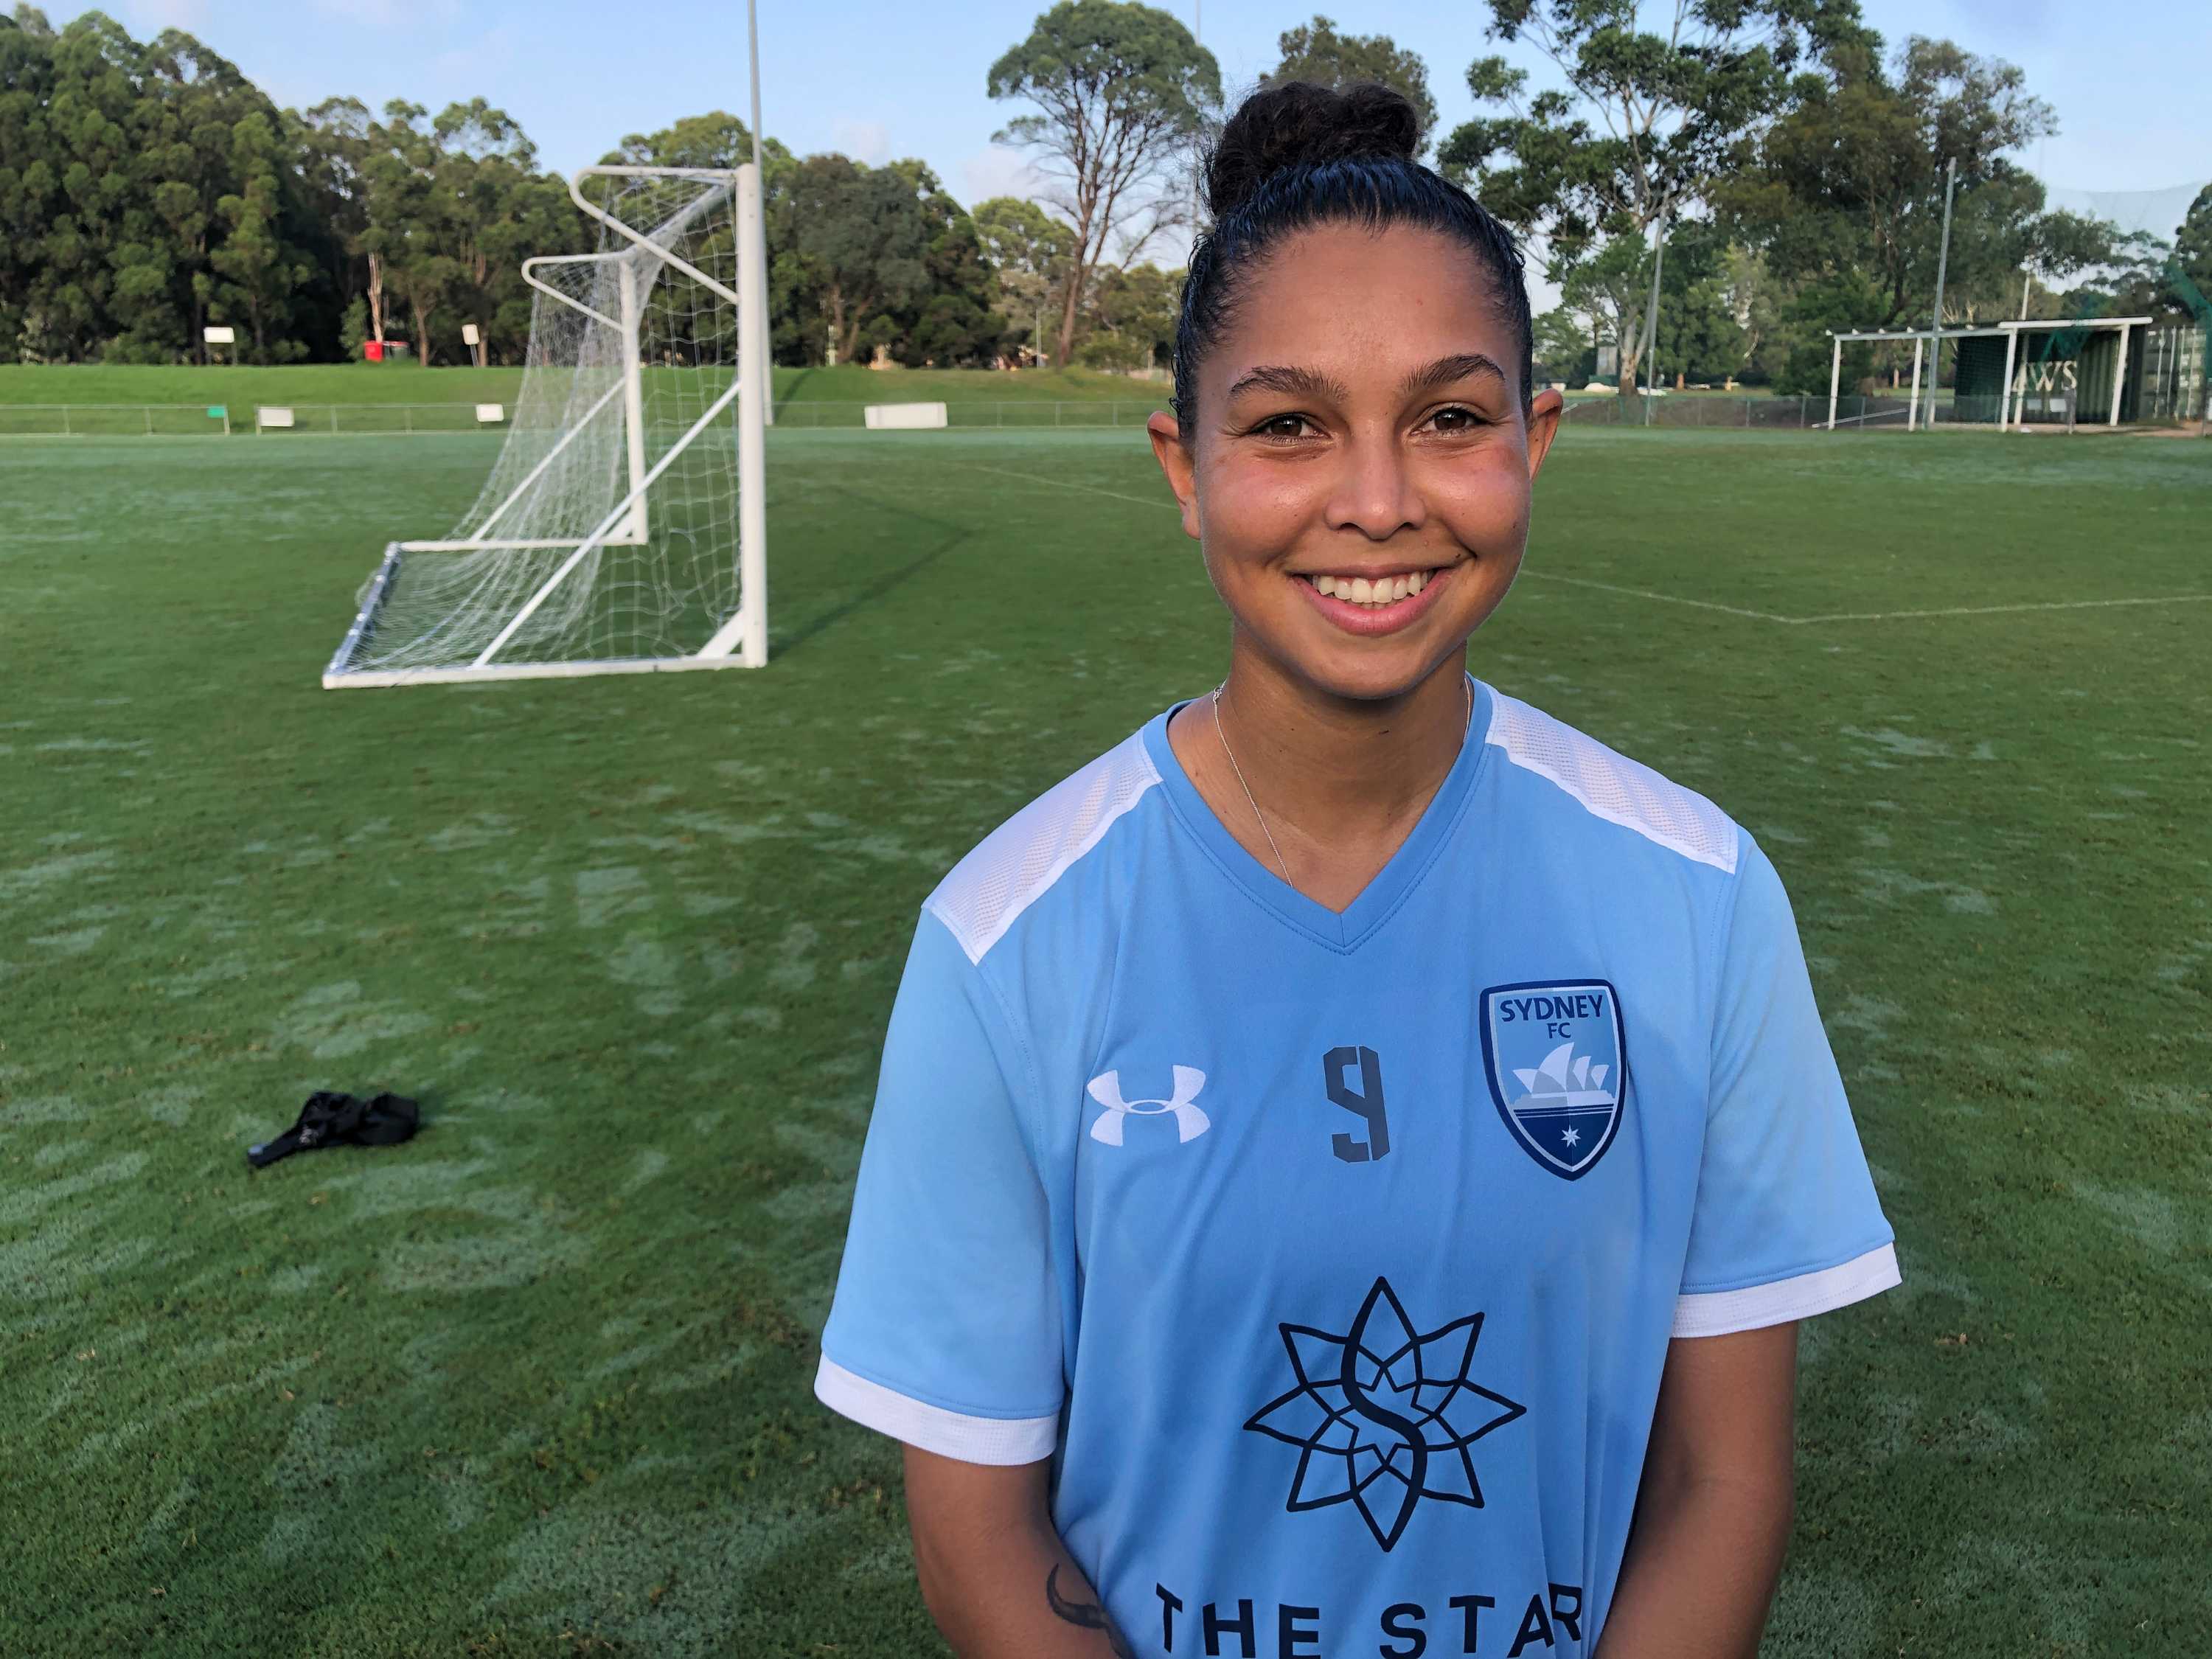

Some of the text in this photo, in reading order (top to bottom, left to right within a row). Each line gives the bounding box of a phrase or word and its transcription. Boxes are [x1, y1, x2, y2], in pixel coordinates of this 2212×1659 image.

[1500, 995, 1603, 1022] SYDNEY
[1547, 1022, 1571, 1039] FC
[1323, 1046, 1391, 1163] 9
[1155, 1582, 1583, 1659] THE STAR
